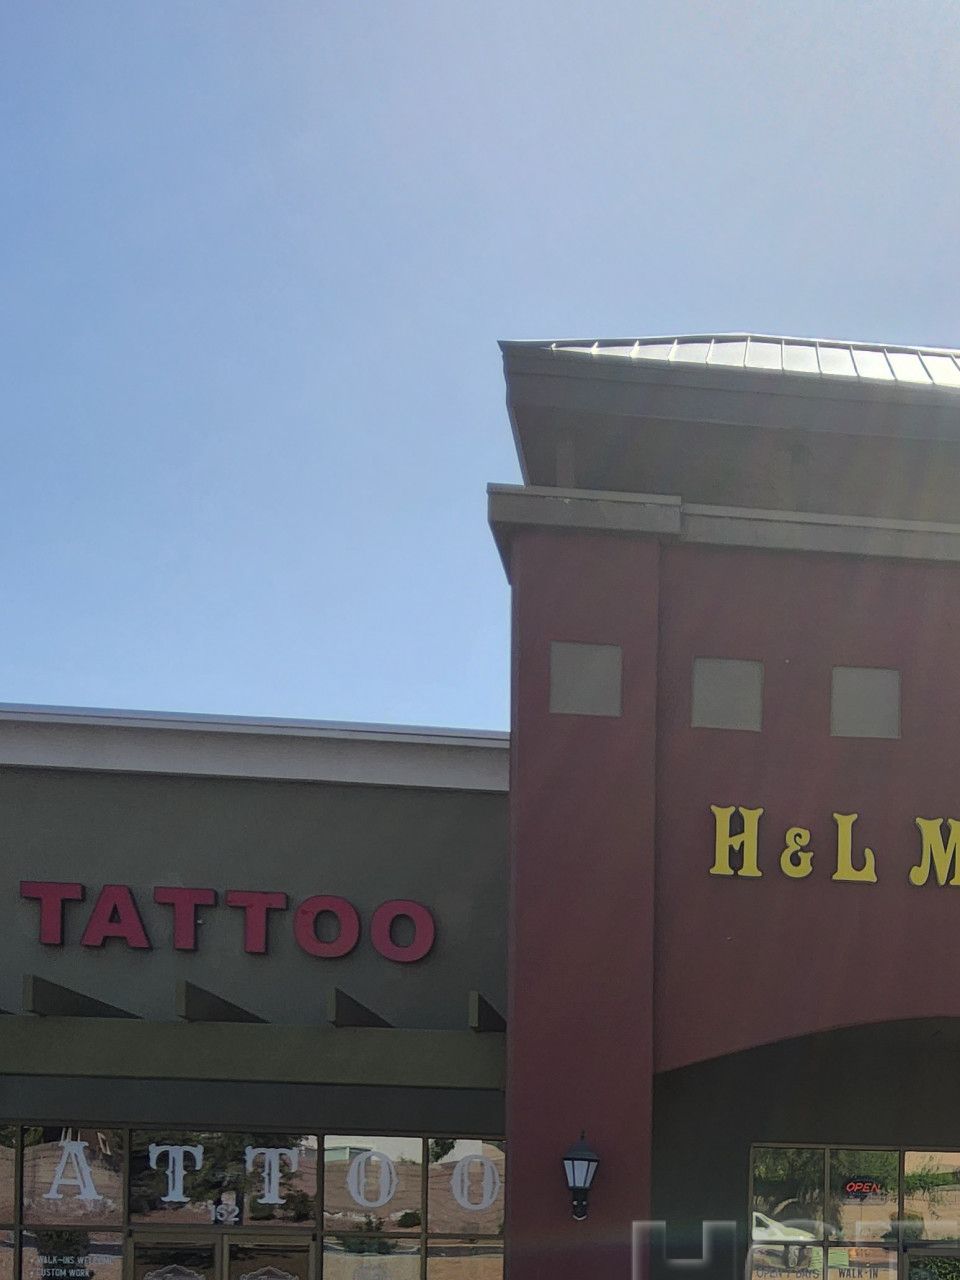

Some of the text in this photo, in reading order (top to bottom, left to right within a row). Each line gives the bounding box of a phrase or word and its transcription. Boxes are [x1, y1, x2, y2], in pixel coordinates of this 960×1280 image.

[709, 804, 764, 878] H
[780, 827, 814, 879] &
[831, 812, 877, 883] L
[19, 880, 436, 962] TATTOO
[846, 1182, 880, 1193] OPEN
